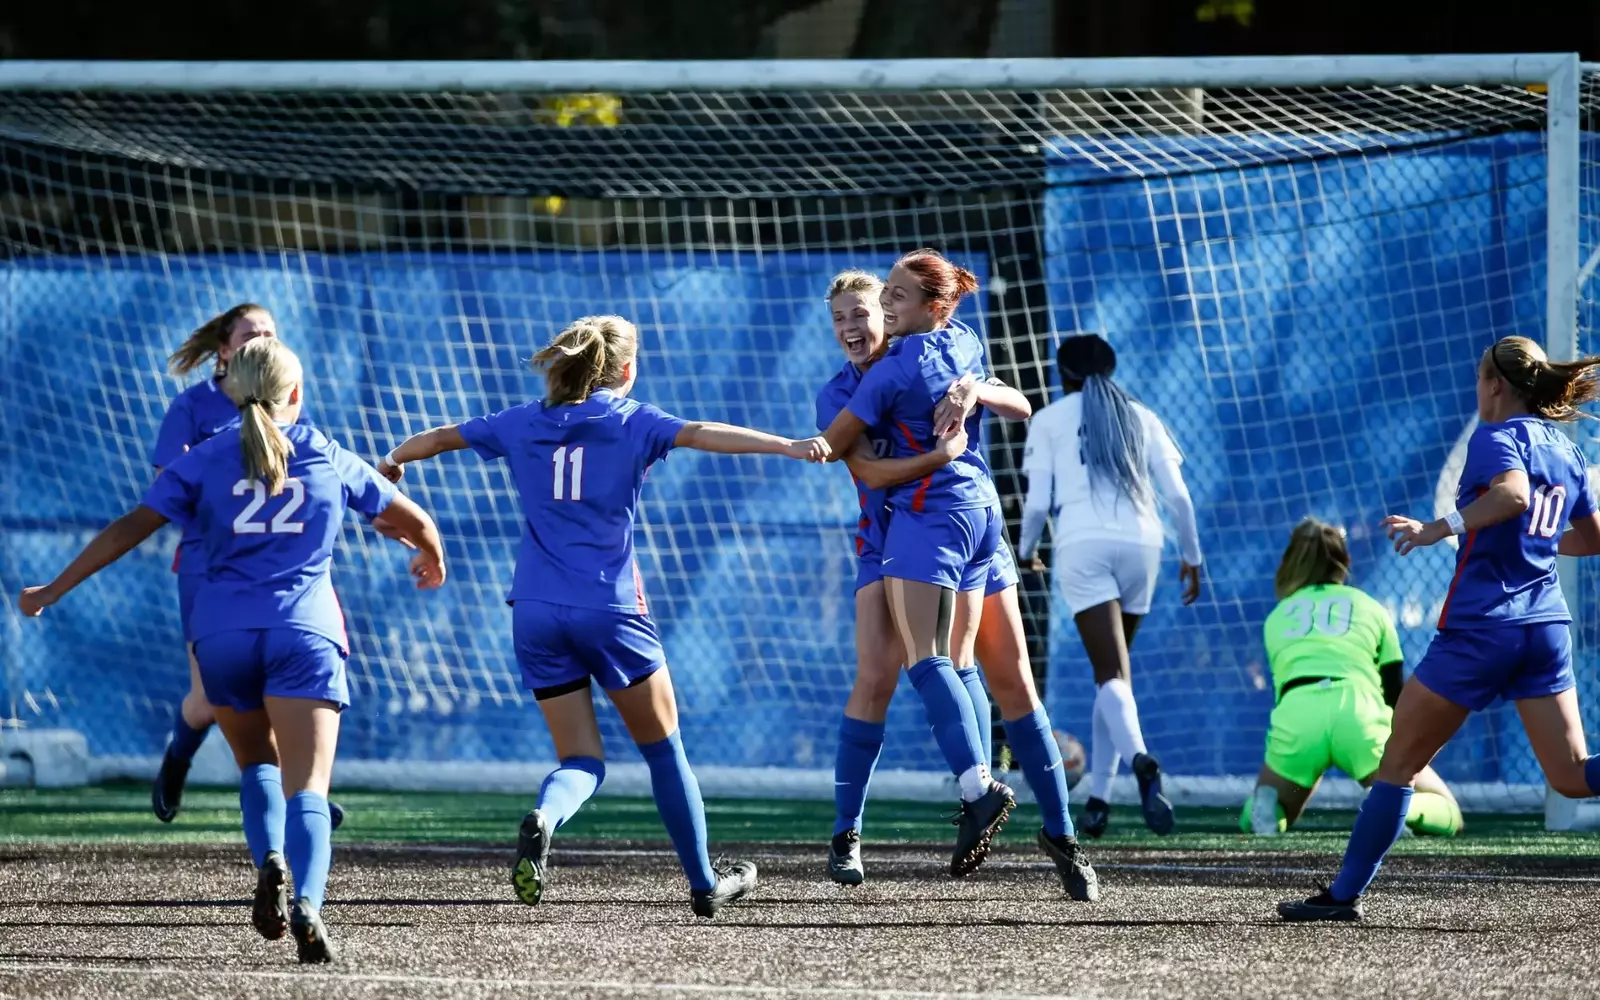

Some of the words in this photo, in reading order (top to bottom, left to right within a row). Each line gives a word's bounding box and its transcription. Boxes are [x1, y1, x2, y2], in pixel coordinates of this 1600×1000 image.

[552, 446, 584, 502] 11
[232, 477, 305, 534] 22
[1527, 483, 1567, 538] 10
[1281, 595, 1354, 638] 30
